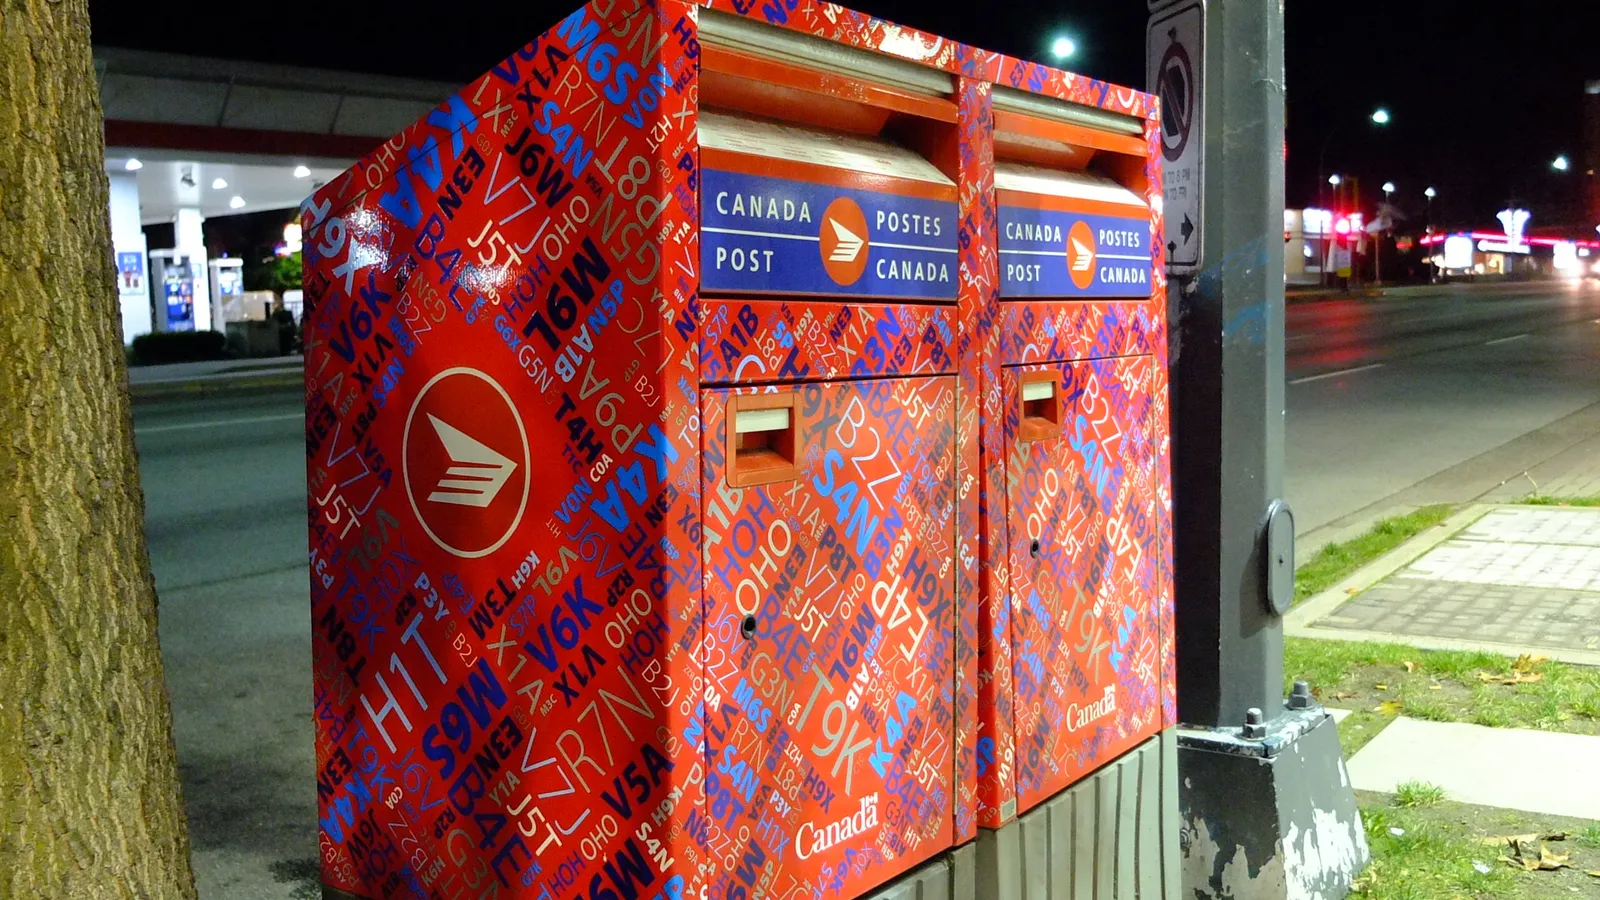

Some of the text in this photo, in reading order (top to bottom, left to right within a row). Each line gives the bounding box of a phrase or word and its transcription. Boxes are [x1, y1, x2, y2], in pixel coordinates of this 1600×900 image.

[557, 7, 639, 105] M6S
[500, 110, 519, 138] M3C
[554, 64, 617, 148] R7N
[646, 113, 674, 154] H2T
[505, 128, 573, 208] J6W
[533, 101, 594, 179] S4N
[437, 146, 486, 221] E3N
[594, 136, 673, 229] P8T
[716, 191, 812, 224] CANADA
[467, 219, 522, 272] J5T
[673, 221, 691, 245] Y1A
[876, 210, 942, 237] POSTES
[1006, 222, 1062, 243] CANADA
[1099, 229, 1140, 248] POSTES
[716, 247, 774, 273] POST
[876, 258, 949, 282] CANADA
[1007, 264, 1041, 282] POST
[1100, 267, 1146, 284] CANADA
[328, 270, 393, 363] V6K
[397, 292, 432, 345] B2Z
[412, 271, 447, 322] G3N
[522, 235, 611, 351] M9L
[588, 279, 624, 335] N5P
[650, 288, 675, 325] Y1A
[554, 323, 595, 383] A1B
[720, 304, 759, 372] A1B
[808, 320, 837, 368] B2Z
[837, 306, 875, 367] X1A
[1080, 304, 1103, 350] X1A
[518, 344, 554, 394] G5N
[634, 375, 661, 407] B2J
[554, 392, 604, 466] T4H
[579, 358, 643, 455] P9A
[901, 386, 931, 430] J5T
[1081, 373, 1122, 462] B2Z
[589, 422, 680, 533] K4A
[835, 395, 902, 511] B2Z
[1069, 414, 1110, 497] S4N
[316, 484, 361, 540] J5T
[645, 482, 679, 528] E3N
[812, 448, 879, 557] S4N
[511, 550, 541, 590] K6H
[532, 545, 579, 596] V9L
[773, 543, 807, 600] E3N
[819, 525, 857, 584] P8T
[863, 506, 903, 580] B3N
[886, 527, 912, 577] K6H
[414, 572, 450, 621] P3Y
[468, 578, 516, 640] T3M
[871, 574, 928, 662] E4P
[902, 546, 951, 632] H9X
[453, 632, 478, 668] B2J
[523, 574, 605, 673] V6K
[756, 593, 810, 681] B4E
[793, 598, 828, 643] J5T
[828, 602, 876, 683] M9L
[1064, 579, 1110, 685] T9K
[360, 611, 448, 754] H1T
[486, 623, 544, 716] X1A
[552, 644, 607, 708] V1X
[641, 658, 680, 708] B2J
[703, 632, 739, 693] B2Z
[751, 652, 795, 717] G3N
[845, 662, 870, 711] A1B
[422, 657, 508, 780] M6S
[539, 693, 558, 717] M3C
[555, 665, 655, 794] R7N
[731, 676, 772, 732] M6S
[796, 662, 872, 796] T9K
[1066, 684, 1116, 732] Canada
[474, 714, 523, 781] E3N
[730, 717, 769, 774] R7N
[868, 690, 917, 778] K4A
[489, 770, 520, 807] Y1A
[601, 743, 675, 820] V5A
[705, 771, 744, 831] P8T
[716, 744, 760, 804] S4N
[769, 788, 791, 819] P3Y
[804, 767, 836, 815] H9X
[913, 757, 938, 791] J5T
[388, 810, 428, 872] B2Z
[506, 794, 562, 856] J5T
[635, 822, 675, 873] S4N
[795, 794, 878, 860] Canada
